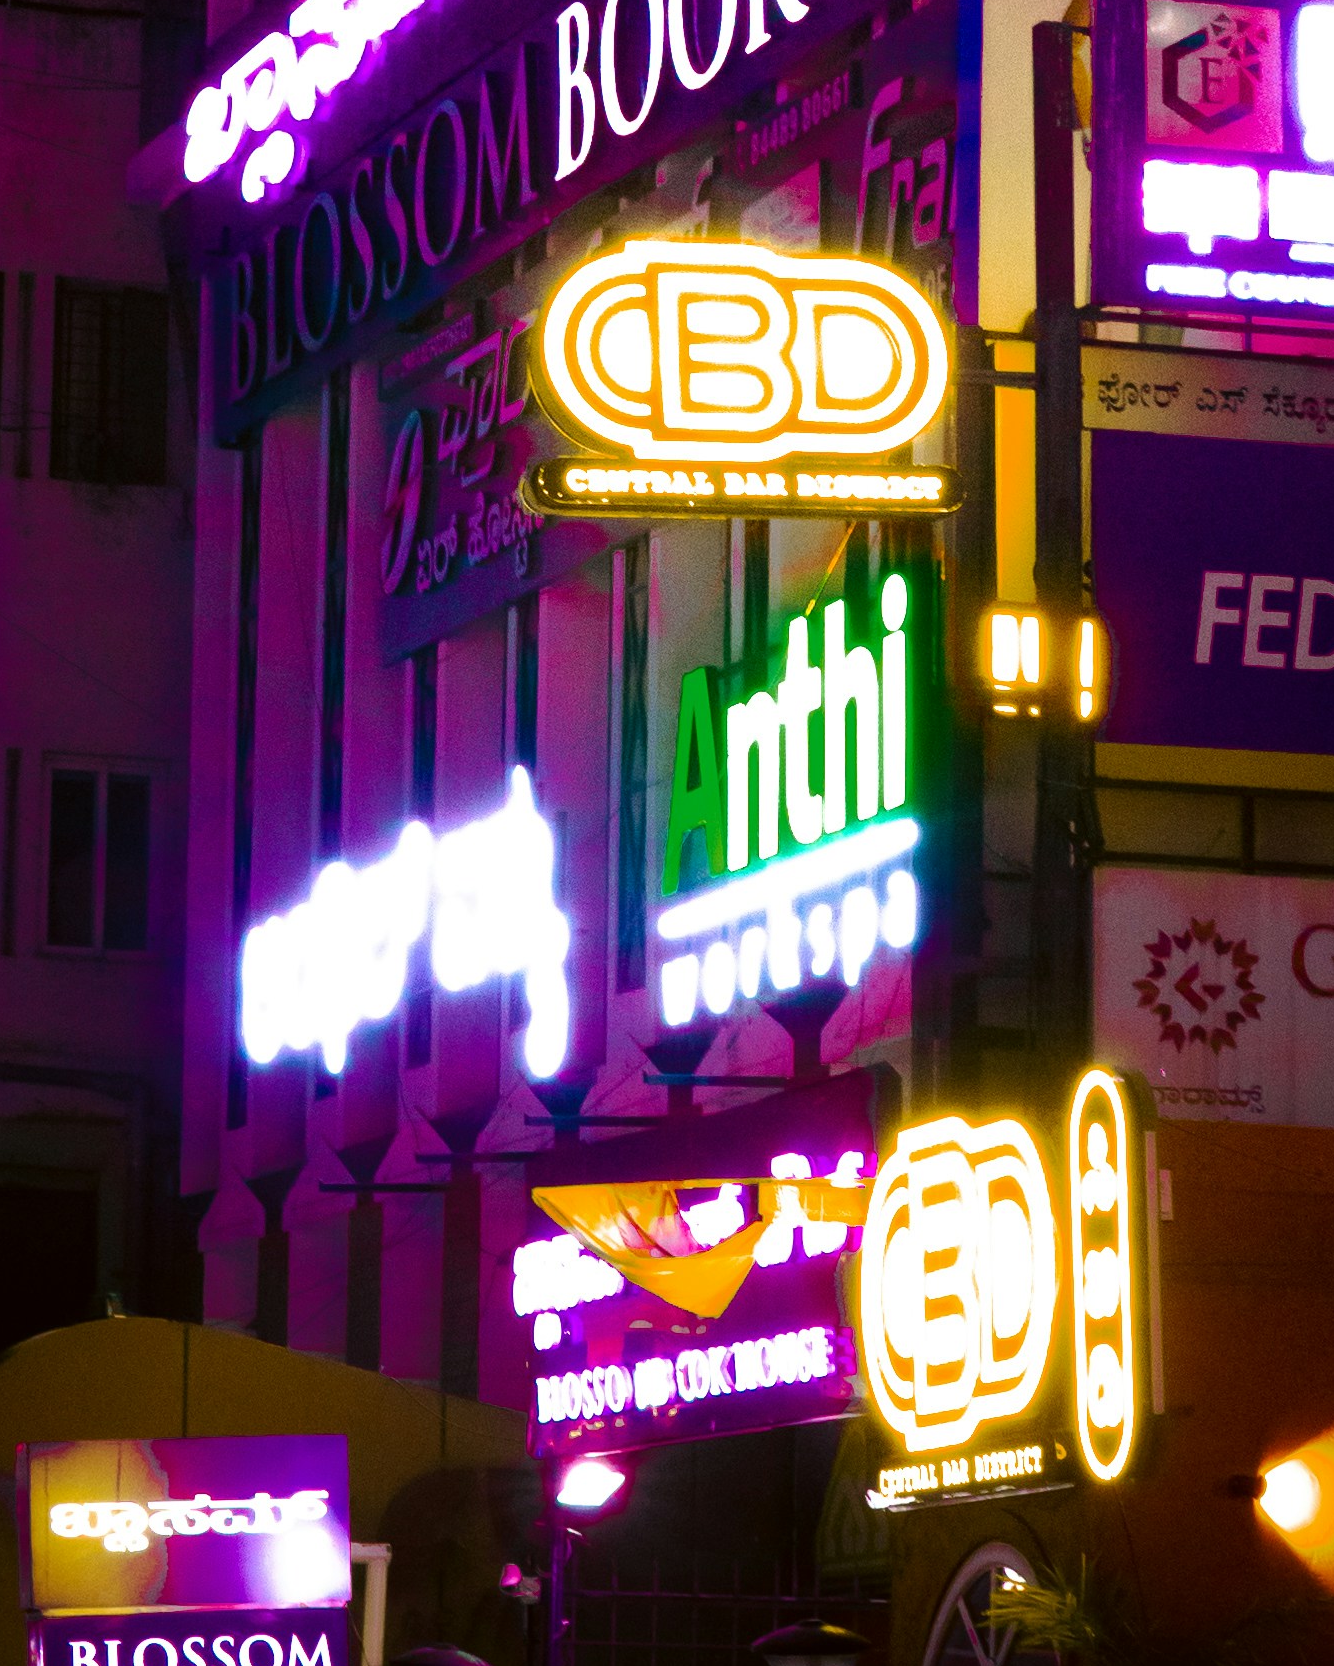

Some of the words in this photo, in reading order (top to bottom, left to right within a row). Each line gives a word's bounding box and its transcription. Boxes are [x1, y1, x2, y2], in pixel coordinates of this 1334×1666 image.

[227, 41, 539, 403] BLOSSOM
[549, 245, 945, 457] CBD
[565, 468, 715, 496] CENTRAL
[661, 573, 907, 897] Anthi
